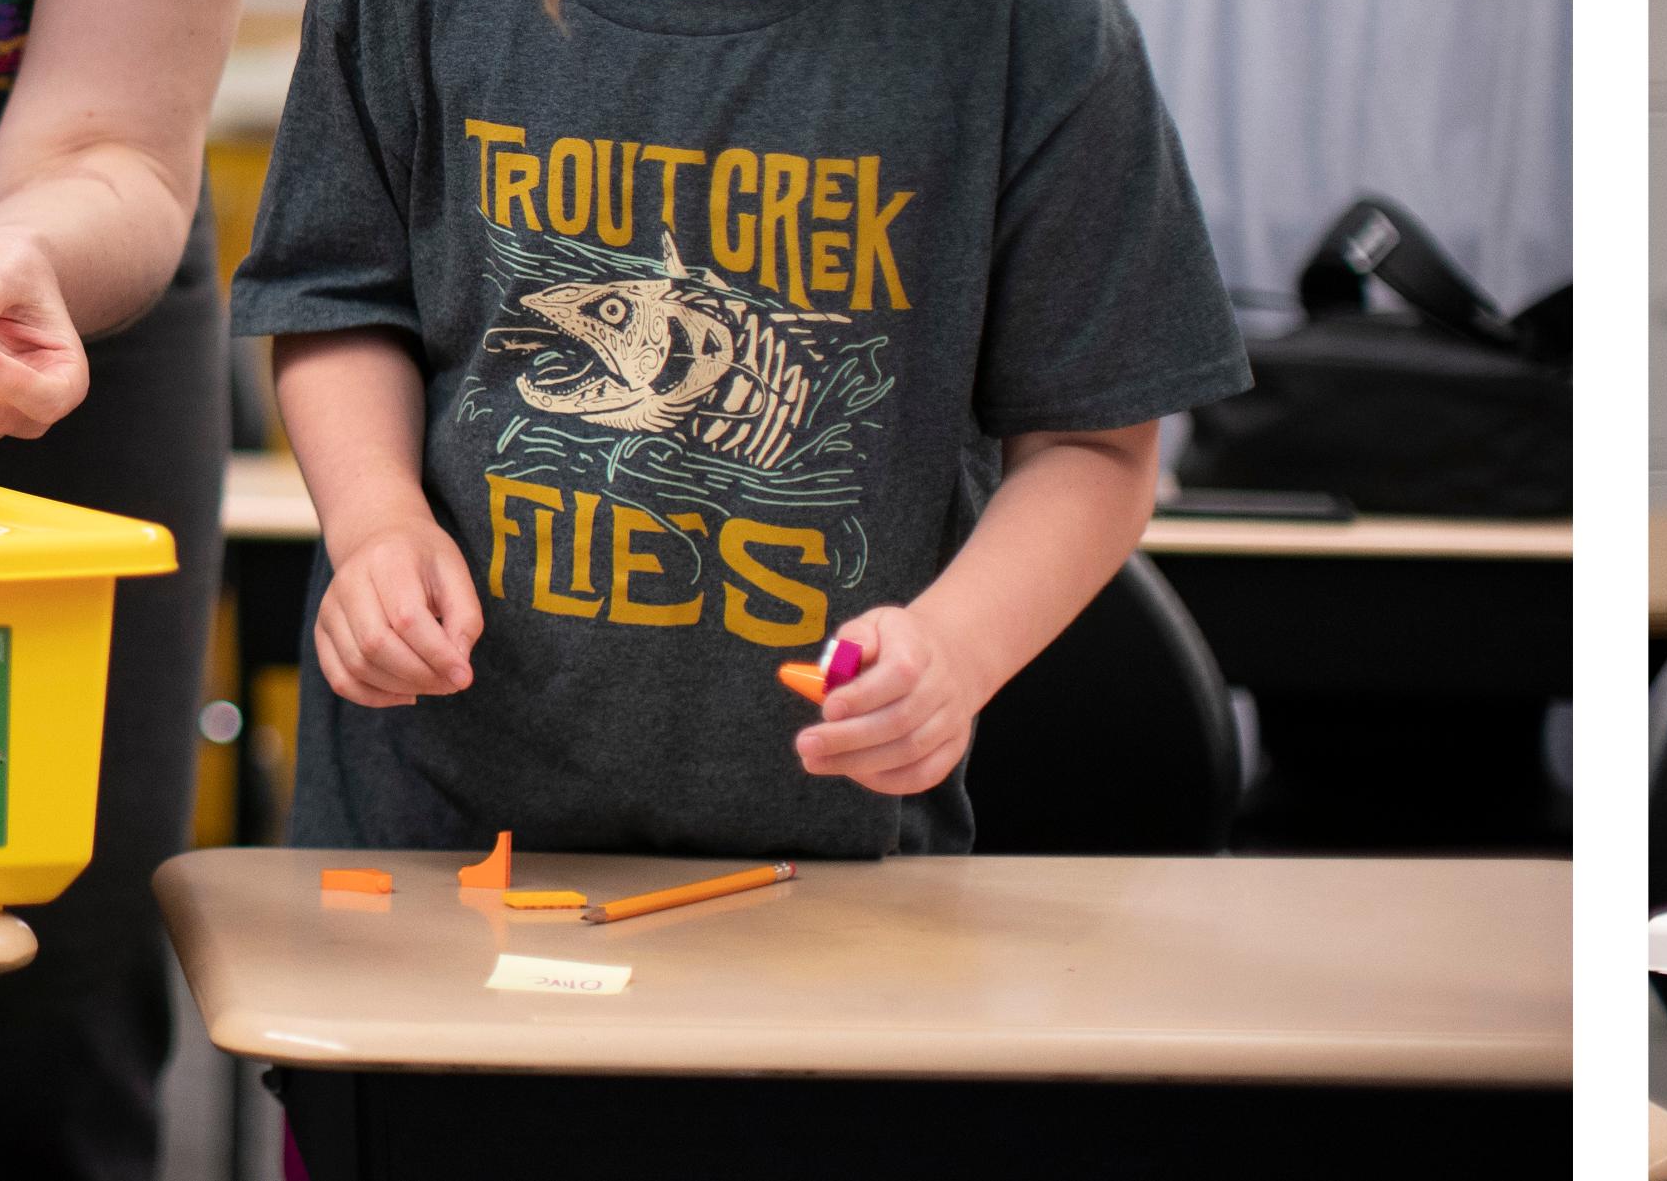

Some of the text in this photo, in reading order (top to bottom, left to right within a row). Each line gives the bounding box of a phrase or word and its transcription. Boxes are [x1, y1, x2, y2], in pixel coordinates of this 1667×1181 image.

[465, 118, 917, 311] TROUT CREEK
[484, 474, 831, 648] FLIES
